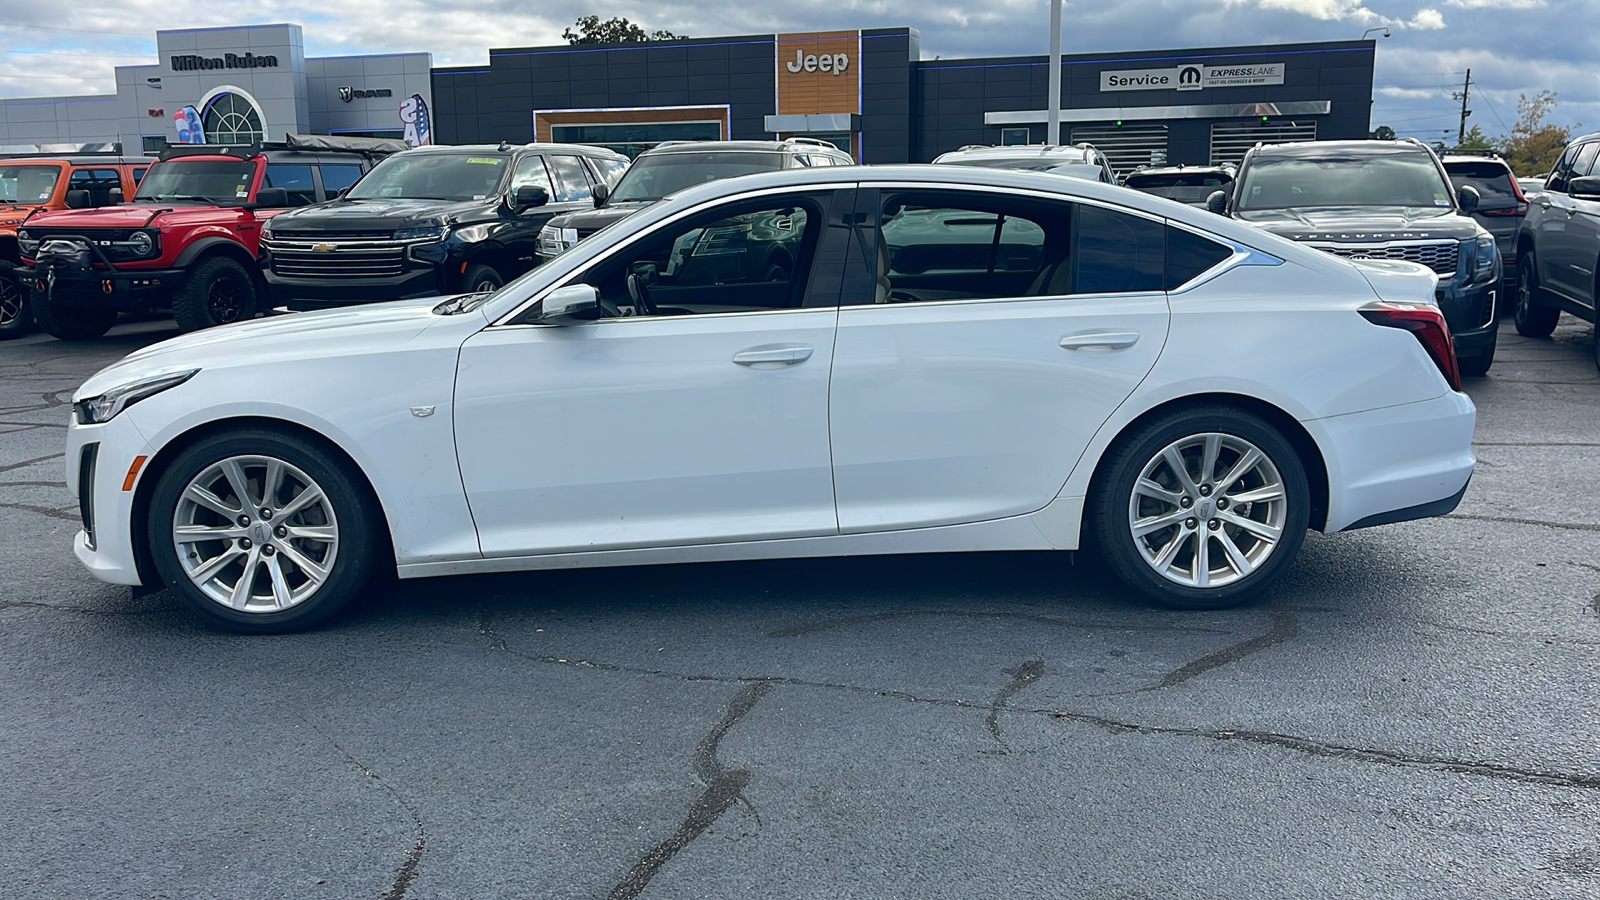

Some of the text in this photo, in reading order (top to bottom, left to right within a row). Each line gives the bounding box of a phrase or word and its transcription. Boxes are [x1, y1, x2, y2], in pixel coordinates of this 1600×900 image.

[171, 52, 278, 71] Milton Ruben
[786, 49, 849, 76] Jeep
[1210, 67, 1276, 77] EXPRESSLANE
[1108, 74, 1169, 86] Service
